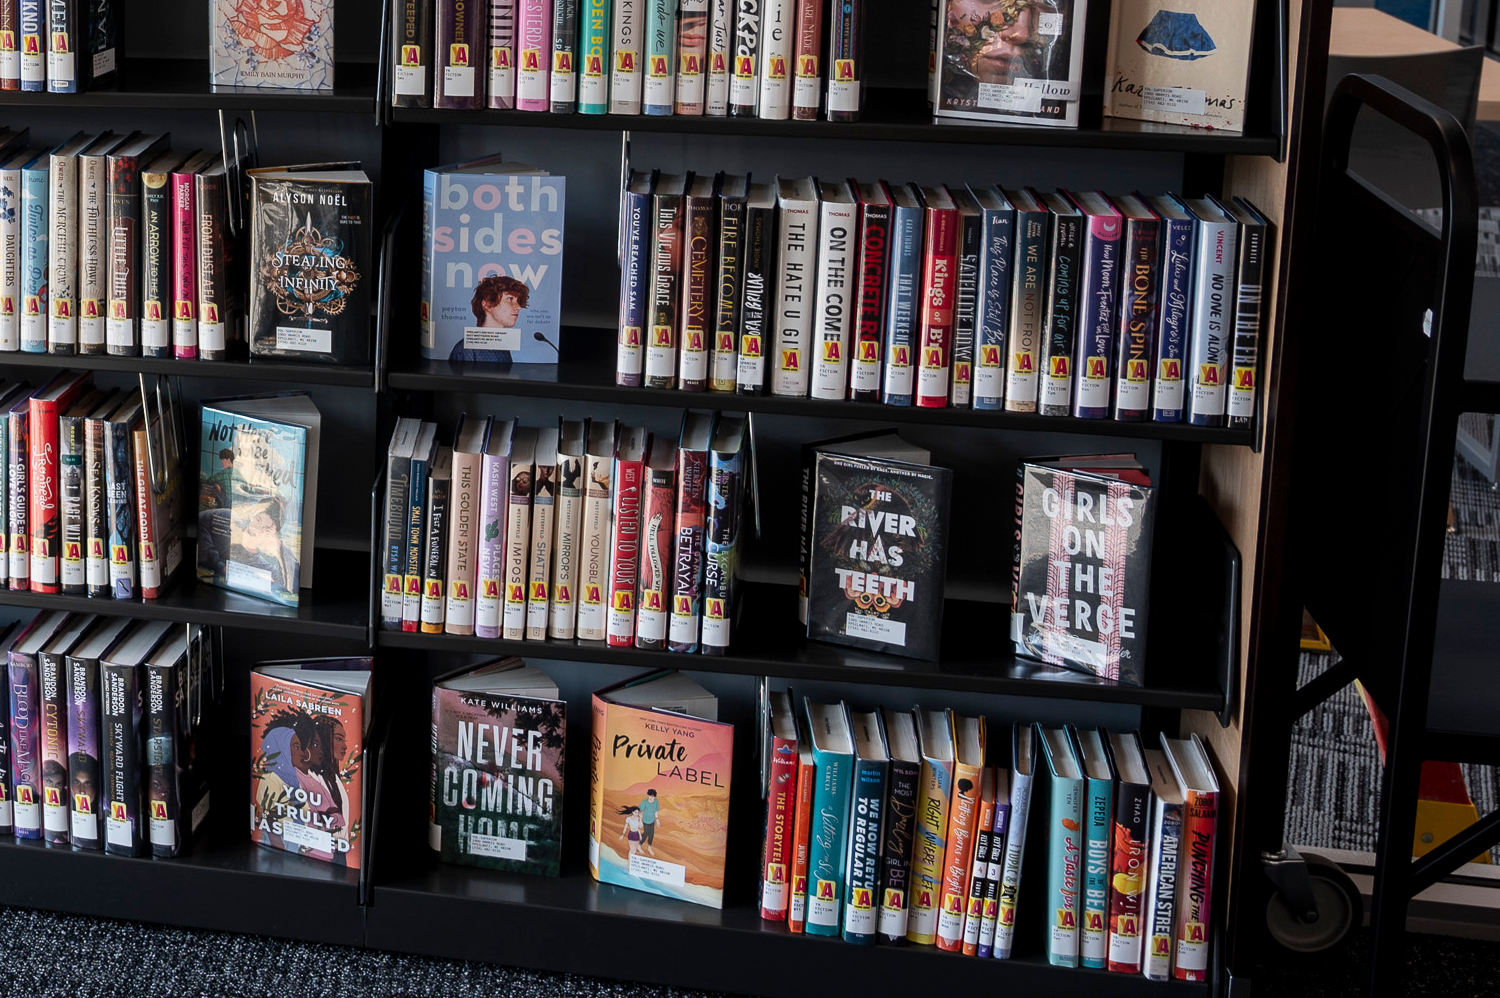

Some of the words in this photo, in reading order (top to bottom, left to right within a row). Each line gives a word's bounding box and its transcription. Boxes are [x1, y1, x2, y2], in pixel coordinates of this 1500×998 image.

[622, 2, 632, 44] KINGS
[273, 192, 314, 204] ALYSON
[320, 194, 347, 206] NOËL
[440, 175, 558, 211] both
[434, 213, 562, 255] sides
[788, 224, 805, 251] THE
[830, 228, 847, 251] ON
[272, 252, 345, 268] STEALING
[631, 241, 640, 289] REACHED
[828, 258, 845, 287] THE
[861, 226, 884, 319] CONCRETE
[280, 277, 338, 290] INFINITY
[446, 262, 548, 290] now
[785, 263, 803, 303] HATE
[824, 294, 843, 341] COME
[463, 465, 472, 488] THIS
[869, 490, 892, 502] THE
[1042, 488, 1134, 528] GIRLS
[458, 491, 470, 537] GOLDEN
[841, 506, 915, 537] RIVER
[458, 540, 468, 571] STATE
[850, 536, 904, 566] HAS
[1063, 527, 1105, 559] ON
[705, 544, 718, 586] CURSE
[1053, 560, 1114, 596] THE
[835, 569, 915, 601] TEETH
[1028, 593, 1135, 639] VERGE
[266, 692, 293, 705] LAILA
[296, 701, 343, 716] SABREEN
[461, 698, 486, 707] KATE
[491, 702, 542, 714] WILLIAMS
[458, 721, 542, 771] NEVER
[645, 723, 669, 733] KELLY
[672, 728, 695, 738] YANG
[115, 723, 123, 770] SKYWARD
[613, 734, 688, 762] Private
[115, 773, 124, 801] FLIGHT
[657, 762, 725, 788] LABEL
[283, 786, 322, 805] YOU
[443, 766, 553, 818] COMING
[274, 803, 333, 828] TRULY
[1088, 840, 1107, 875] BOYS
[1159, 835, 1178, 899] AMERICAN
[1189, 831, 1209, 907] PUNCHING
